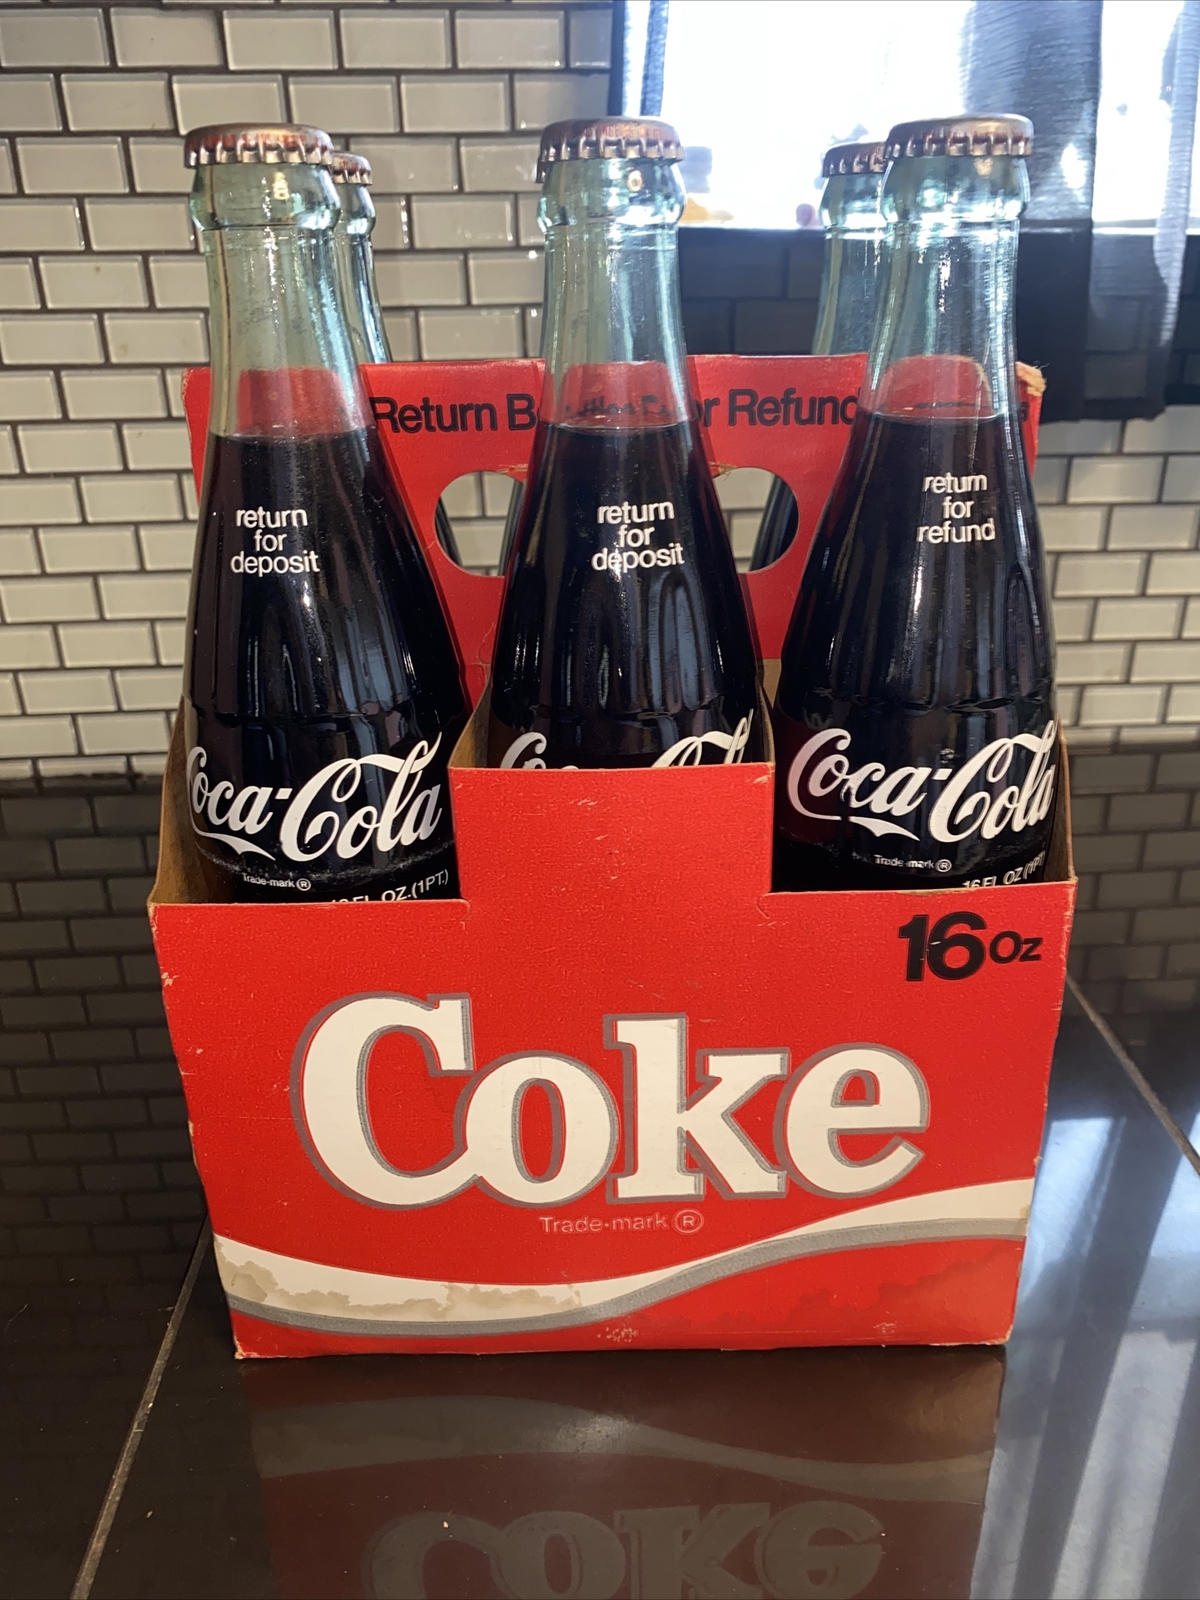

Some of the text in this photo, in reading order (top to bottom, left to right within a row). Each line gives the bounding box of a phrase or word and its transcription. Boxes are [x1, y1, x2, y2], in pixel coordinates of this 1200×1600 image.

[369, 397, 498, 434] Return
[923, 472, 988, 493] return
[236, 506, 308, 528] return
[597, 501, 675, 524] return
[942, 496, 975, 519] for
[254, 529, 288, 552] for
[617, 524, 656, 548] for
[916, 517, 996, 544] refund
[230, 550, 320, 578] deposit
[591, 542, 685, 574] deposit
[787, 719, 1057, 843] Coca-Cola
[185, 731, 443, 863] Coca-Cola
[242, 872, 296, 888] Trade-mark
[898, 911, 988, 982] 16
[290, 990, 931, 1211] Coke
[538, 1213, 669, 1234] Trade-mark
